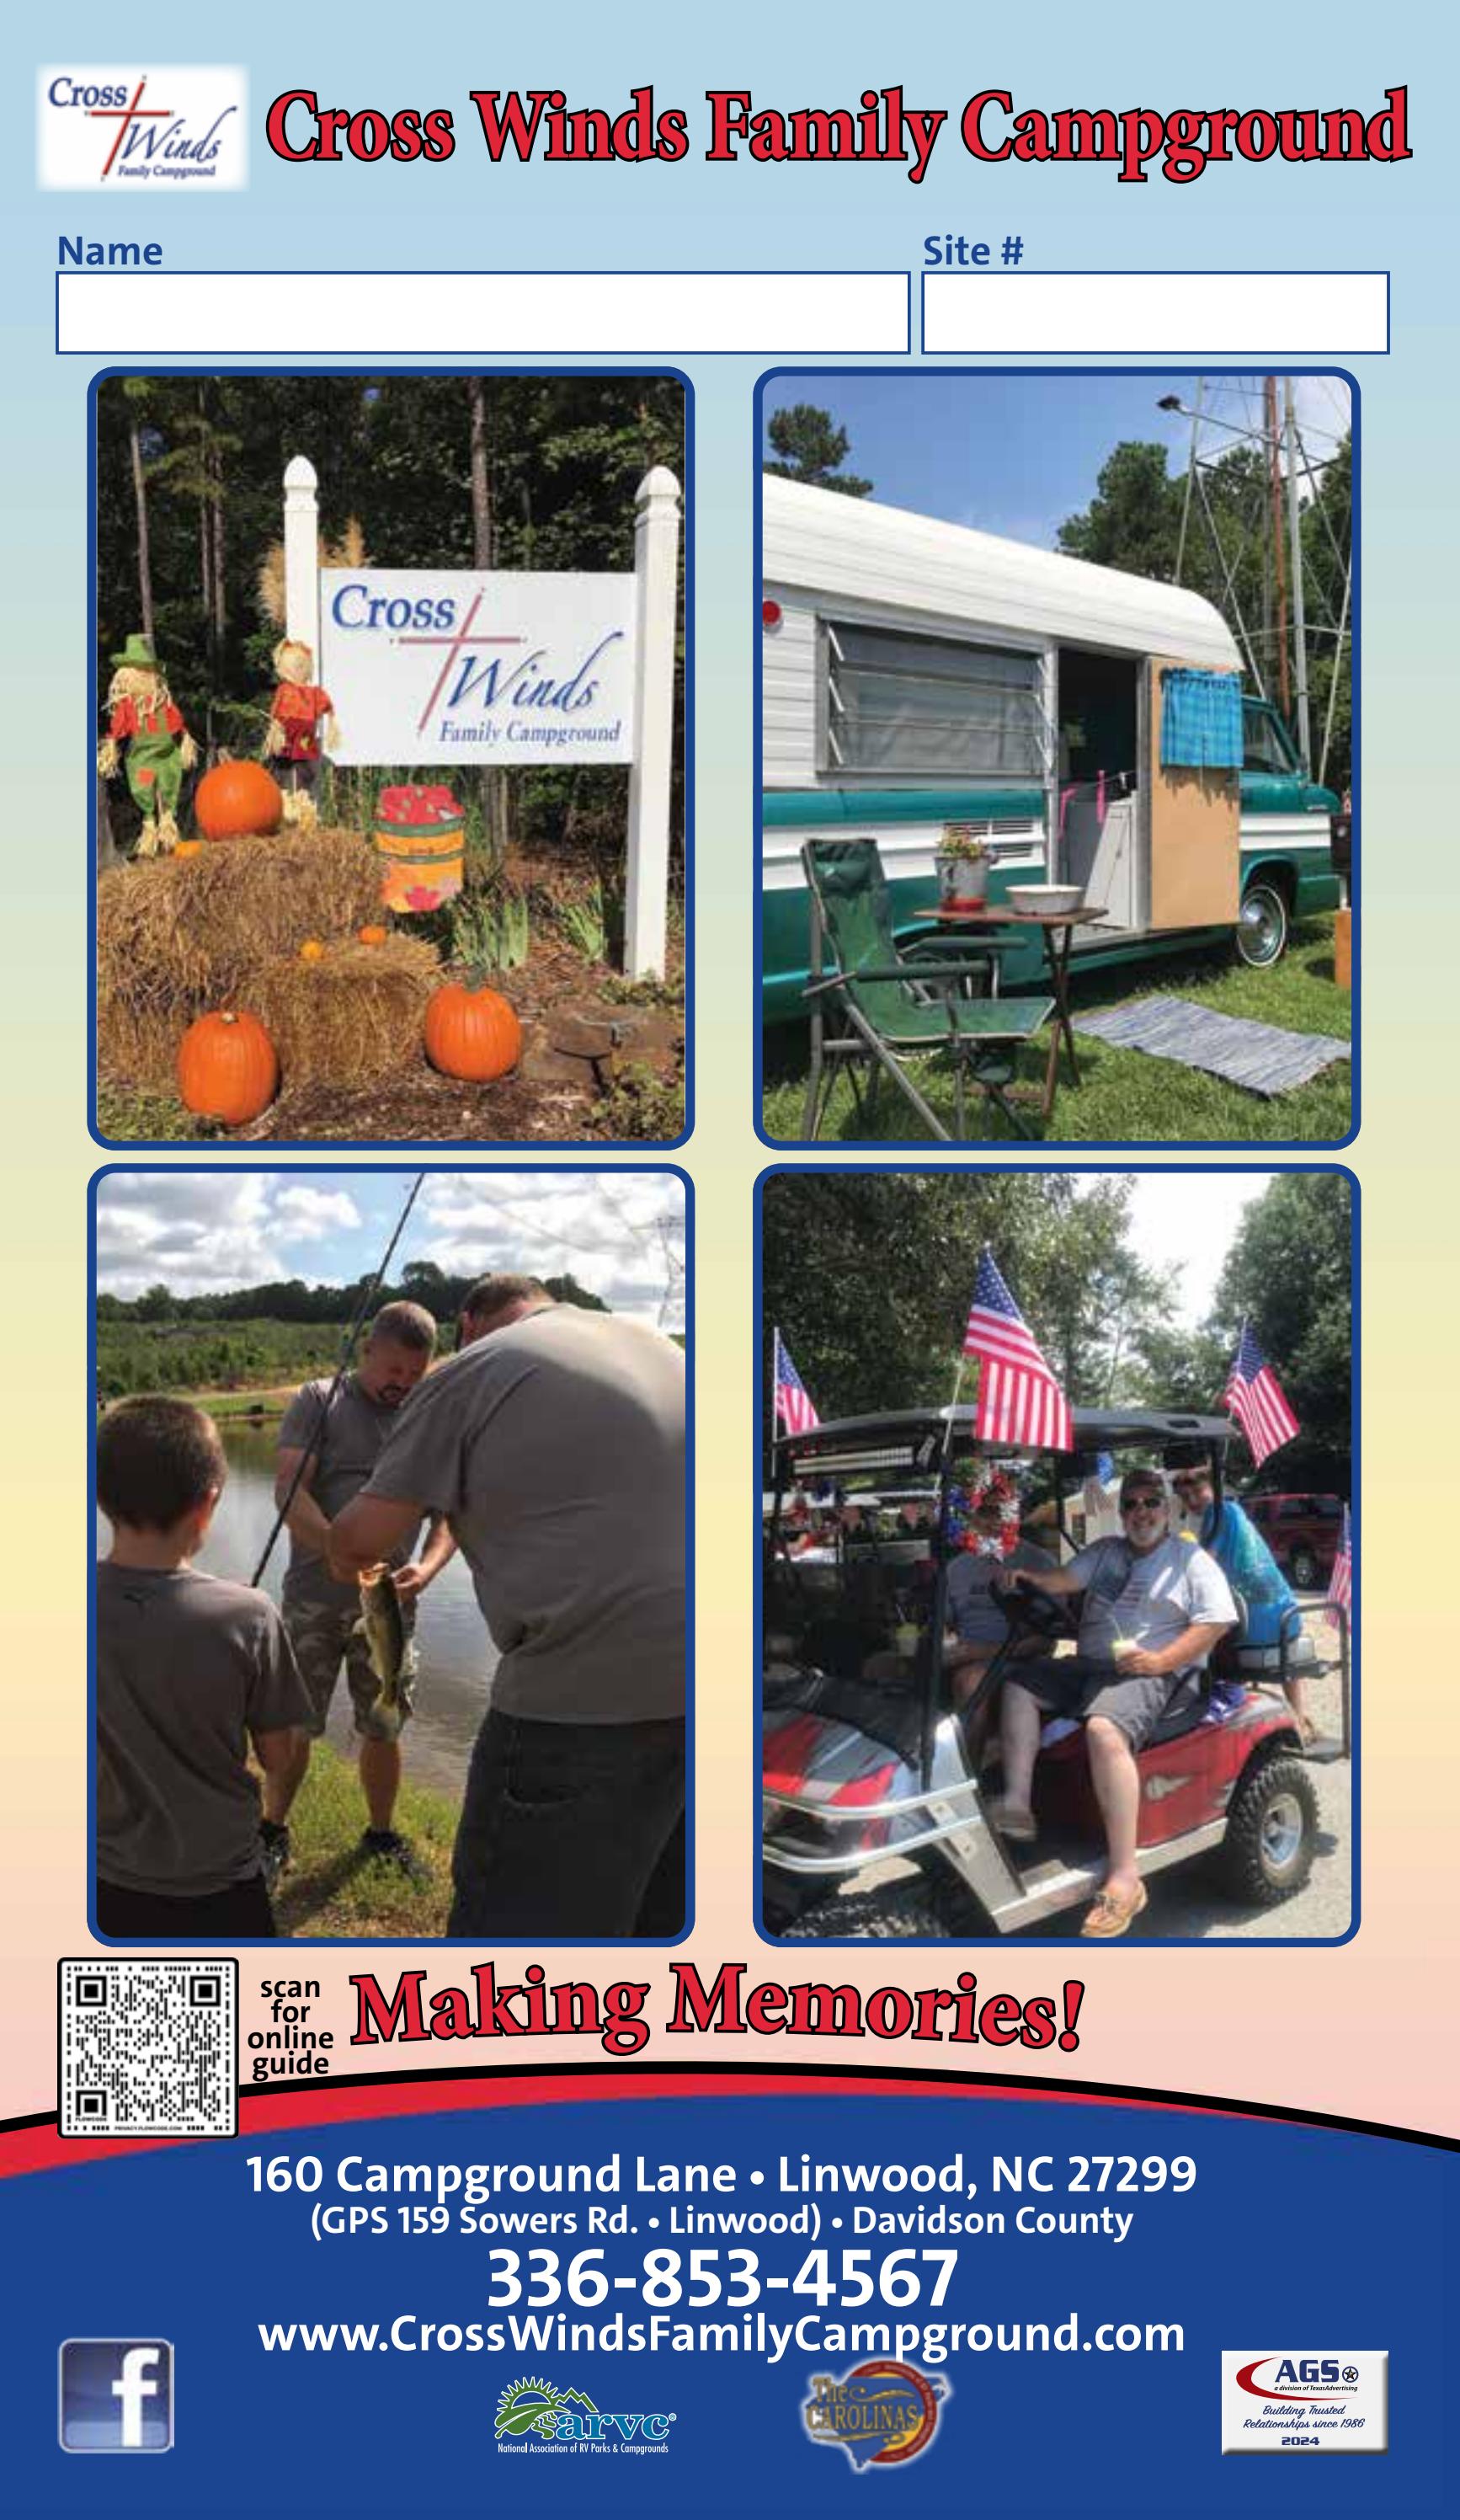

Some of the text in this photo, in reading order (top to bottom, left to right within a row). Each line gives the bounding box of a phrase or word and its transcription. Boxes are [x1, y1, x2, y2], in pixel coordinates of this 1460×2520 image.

[48, 77, 128, 107] Cross
[121, 106, 238, 163] Winds
[265, 85, 1414, 184] Cross Winds Family Campground
[118, 165, 216, 179] Family Campground
[57, 235, 163, 266] Name
[923, 235, 1025, 266] Site #
[332, 584, 456, 629] Cross
[447, 631, 625, 713] Winds
[438, 720, 621, 746] Family Campground
[260, 1980, 321, 1998] scan
[270, 1998, 311, 2023] for
[349, 1960, 1086, 2057] Making Memories!
[248, 2024, 334, 2049] online
[252, 2049, 329, 2082] guide
[246, 2153, 1197, 2204] 160 Campground Lane Linwood, NC 27299
[311, 2202, 1135, 2243] (GPS 159 Sowers Rd. Linwood) Davidson County
[488, 2248, 959, 2308] 336-853-4567
[258, 2312, 1186, 2364] www.CrossWindsFamilyCampground.com
[1275, 2359, 1340, 2383] AGS
[111, 2346, 160, 2448] f
[812, 2376, 848, 2403] The
[806, 2404, 918, 2432] CAROLINAS
[1243, 2418, 1366, 2432] Relationships since 1986
[1262, 2405, 1346, 2420] Building Trusted
[498, 2443, 669, 2455] National Association of RV Parks & Campgrounds
[1281, 2437, 1320, 2446] 2024
